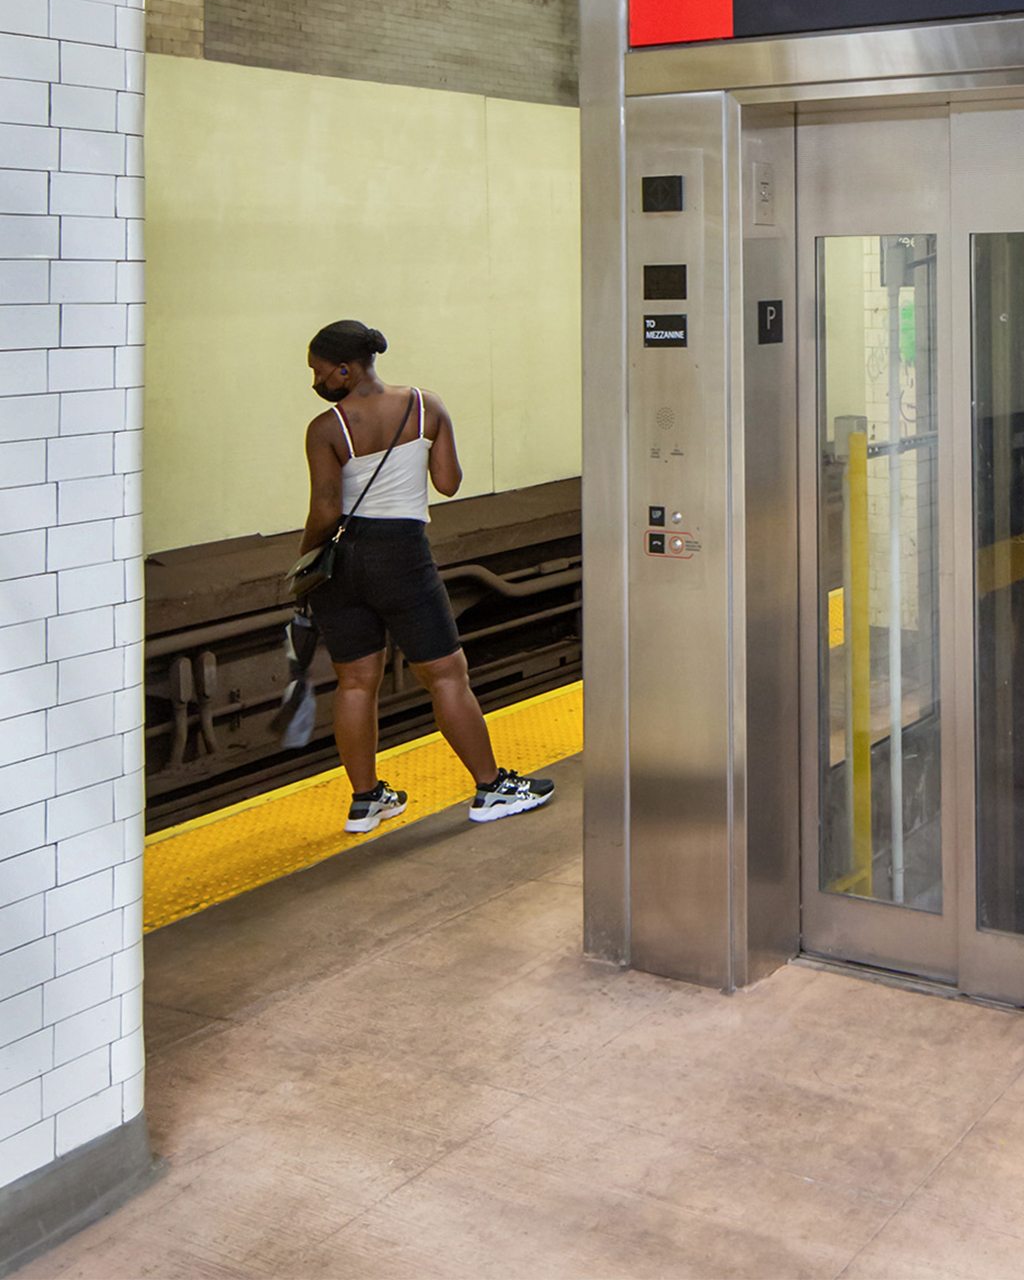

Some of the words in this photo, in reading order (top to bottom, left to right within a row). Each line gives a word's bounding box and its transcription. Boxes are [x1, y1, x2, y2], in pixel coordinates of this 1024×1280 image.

[767, 307, 776, 330] P
[646, 320, 655, 328] TO
[646, 331, 684, 339] MEZZANINE
[652, 510, 662, 518] UP
